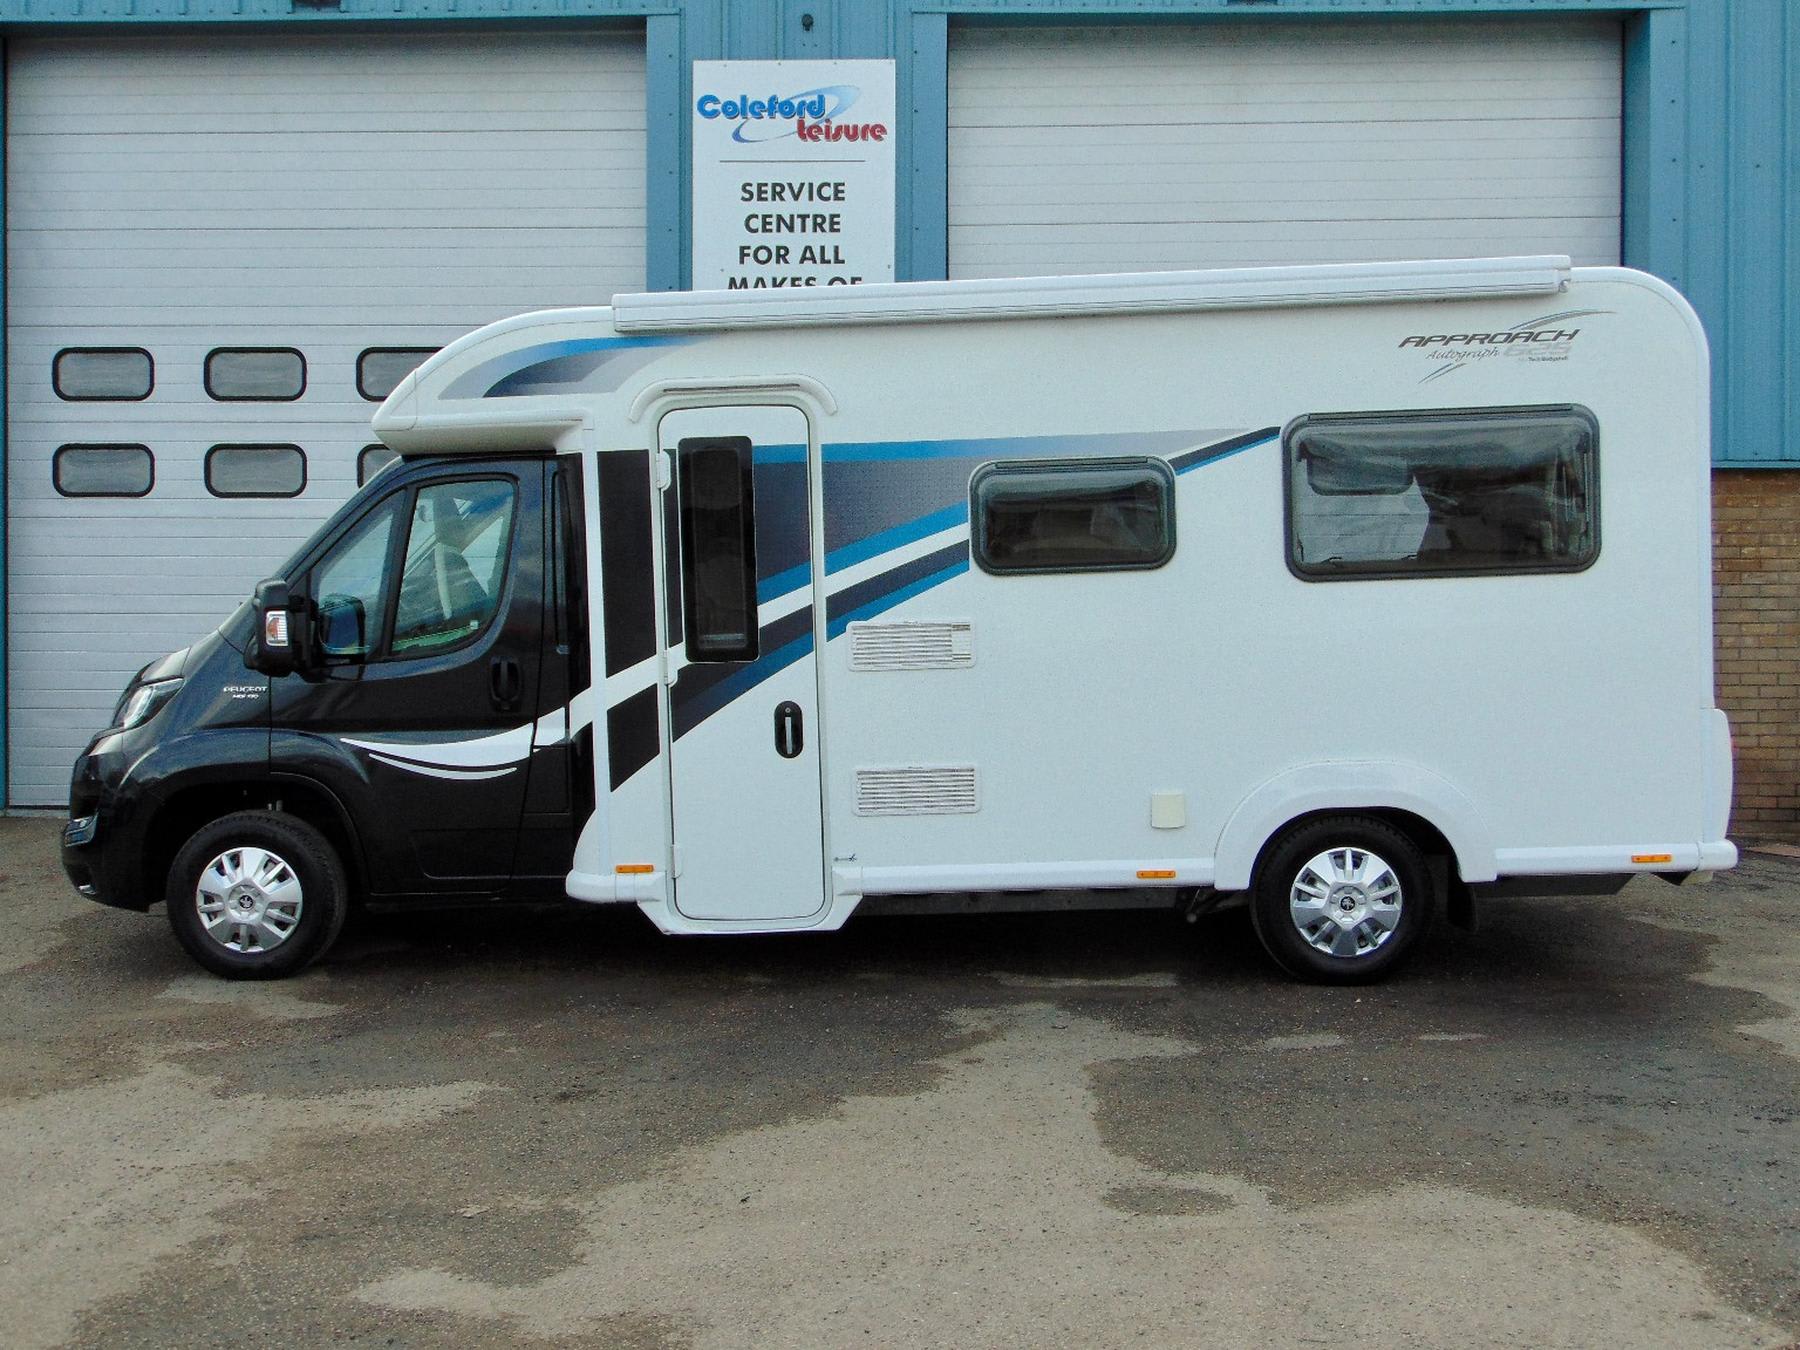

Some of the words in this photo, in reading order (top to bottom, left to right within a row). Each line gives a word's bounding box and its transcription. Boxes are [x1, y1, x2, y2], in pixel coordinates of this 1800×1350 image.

[697, 94, 826, 120] Coleford
[740, 182, 846, 202] SERVICE
[744, 213, 841, 234] CENTRE
[738, 245, 790, 265] FOR
[799, 245, 846, 265] ALL
[1398, 328, 1581, 348] APPROACH
[1425, 346, 1499, 362] Autograph
